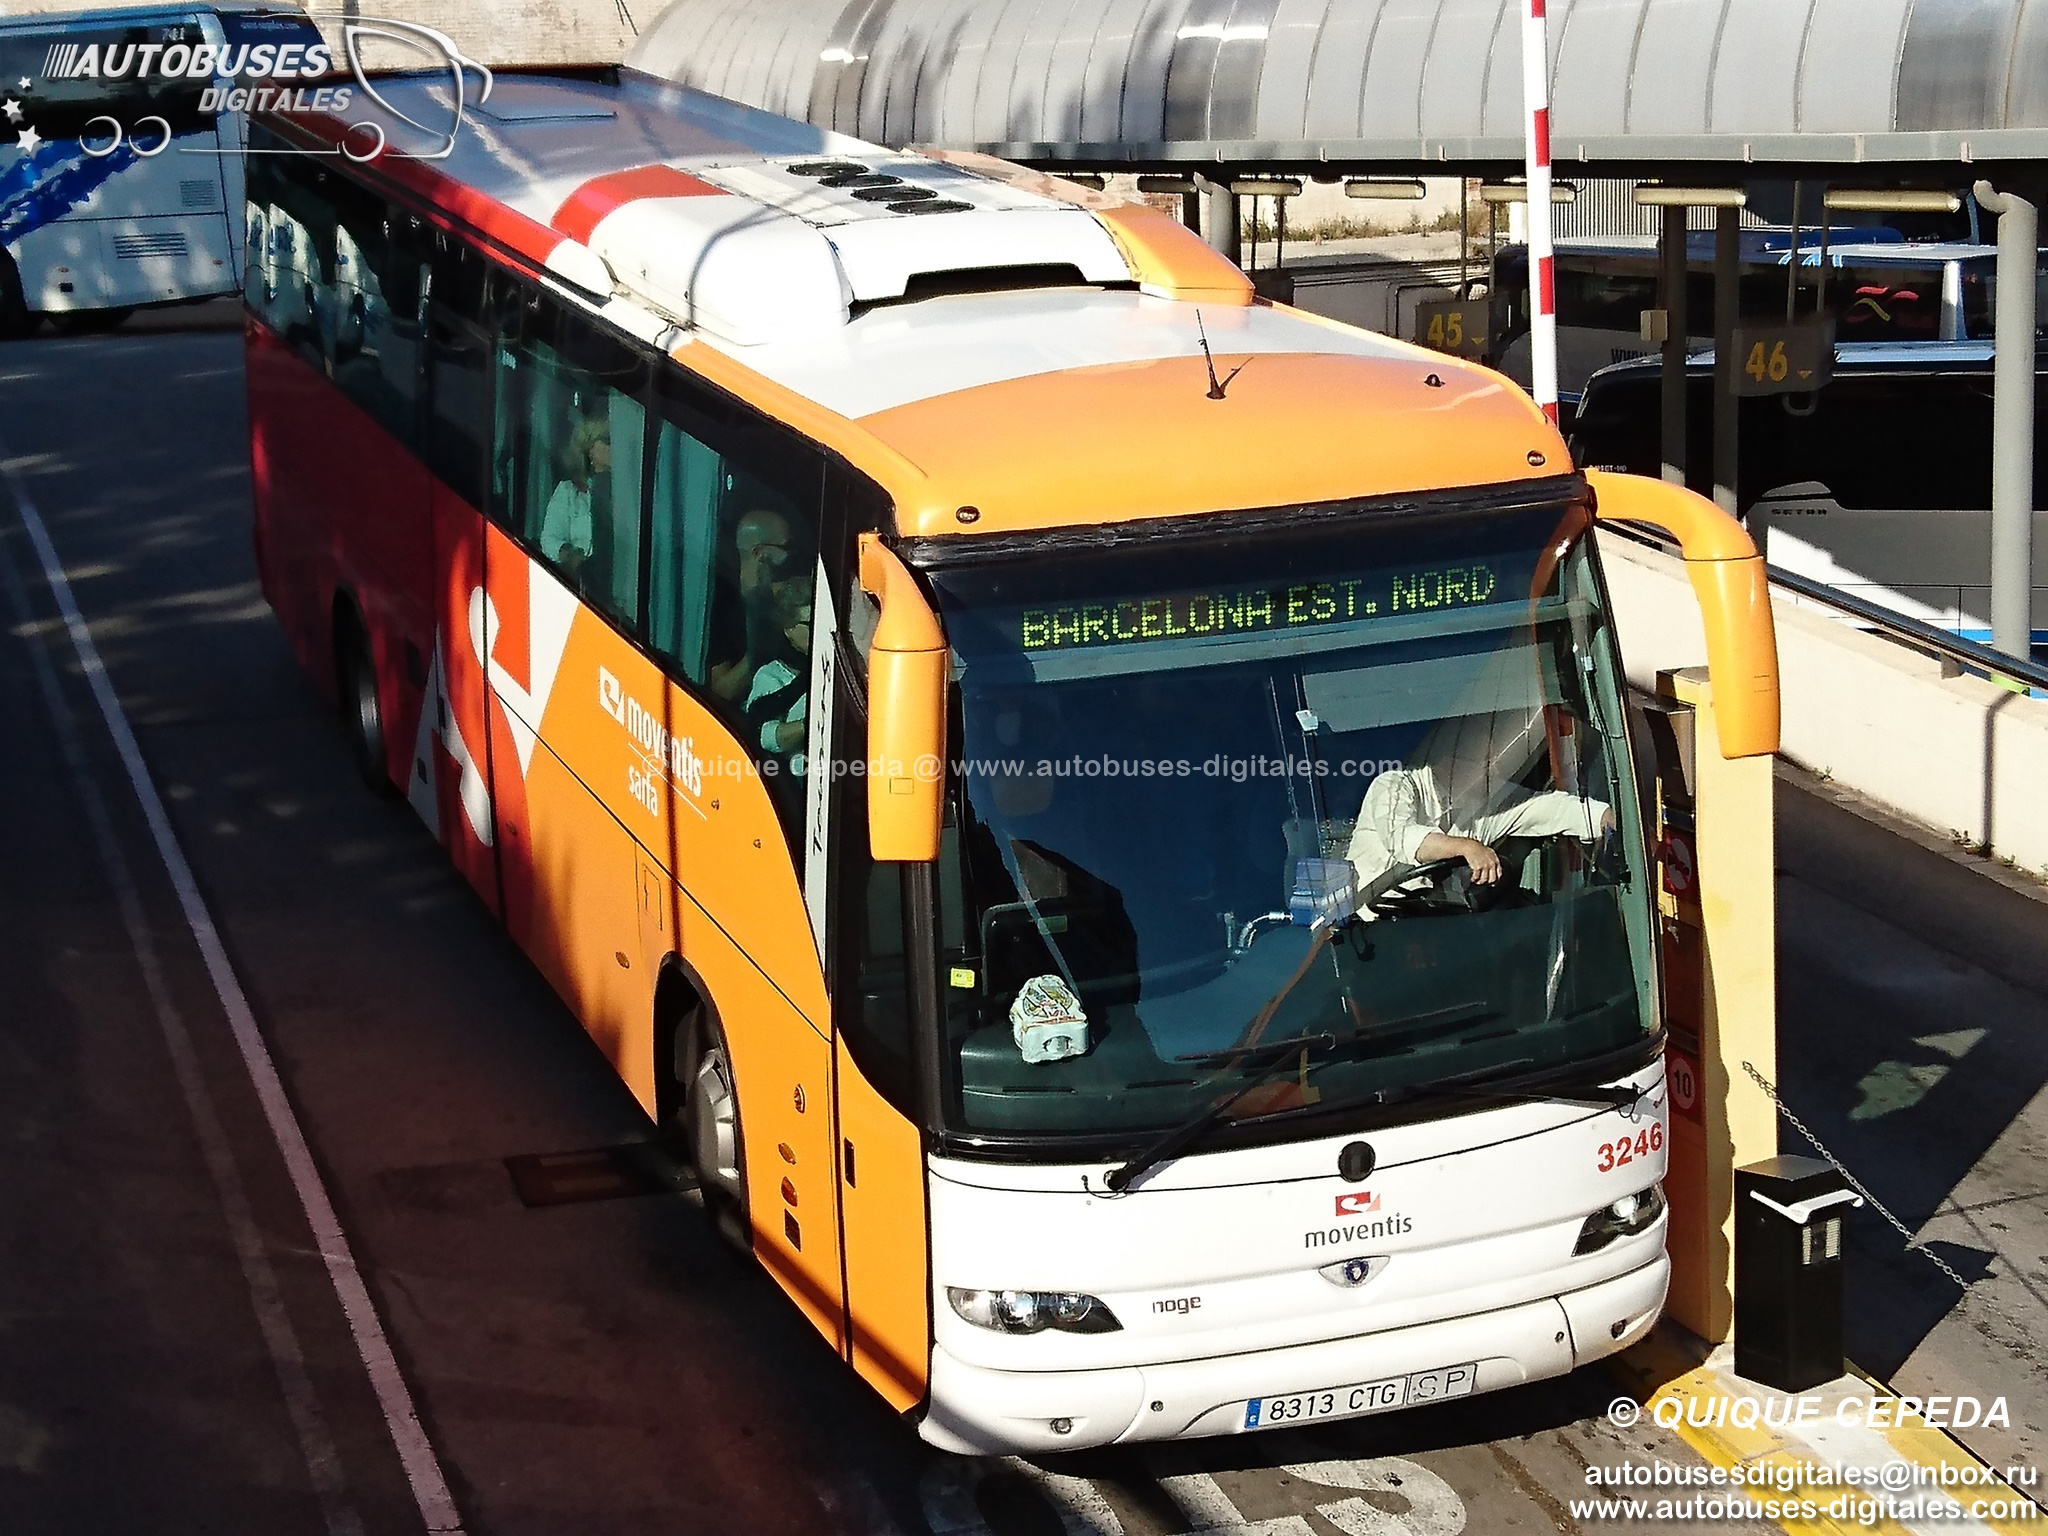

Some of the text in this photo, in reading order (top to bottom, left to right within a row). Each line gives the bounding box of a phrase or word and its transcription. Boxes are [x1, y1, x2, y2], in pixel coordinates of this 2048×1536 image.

[1426, 312, 1463, 348] 45
[1745, 340, 1789, 383] 46
[1022, 564, 1497, 648] BARCELONA EST. NORD
[627, 695, 702, 798] moventis
[628, 763, 659, 818] sarfa
[1673, 1069, 1692, 1099] 10
[1597, 1122, 1663, 1172] 3246
[1304, 1212, 1412, 1248] moventis
[1152, 1296, 1201, 1314] noge
[1269, 1393, 1335, 1421] 8313
[1348, 1383, 1396, 1411] CTG
